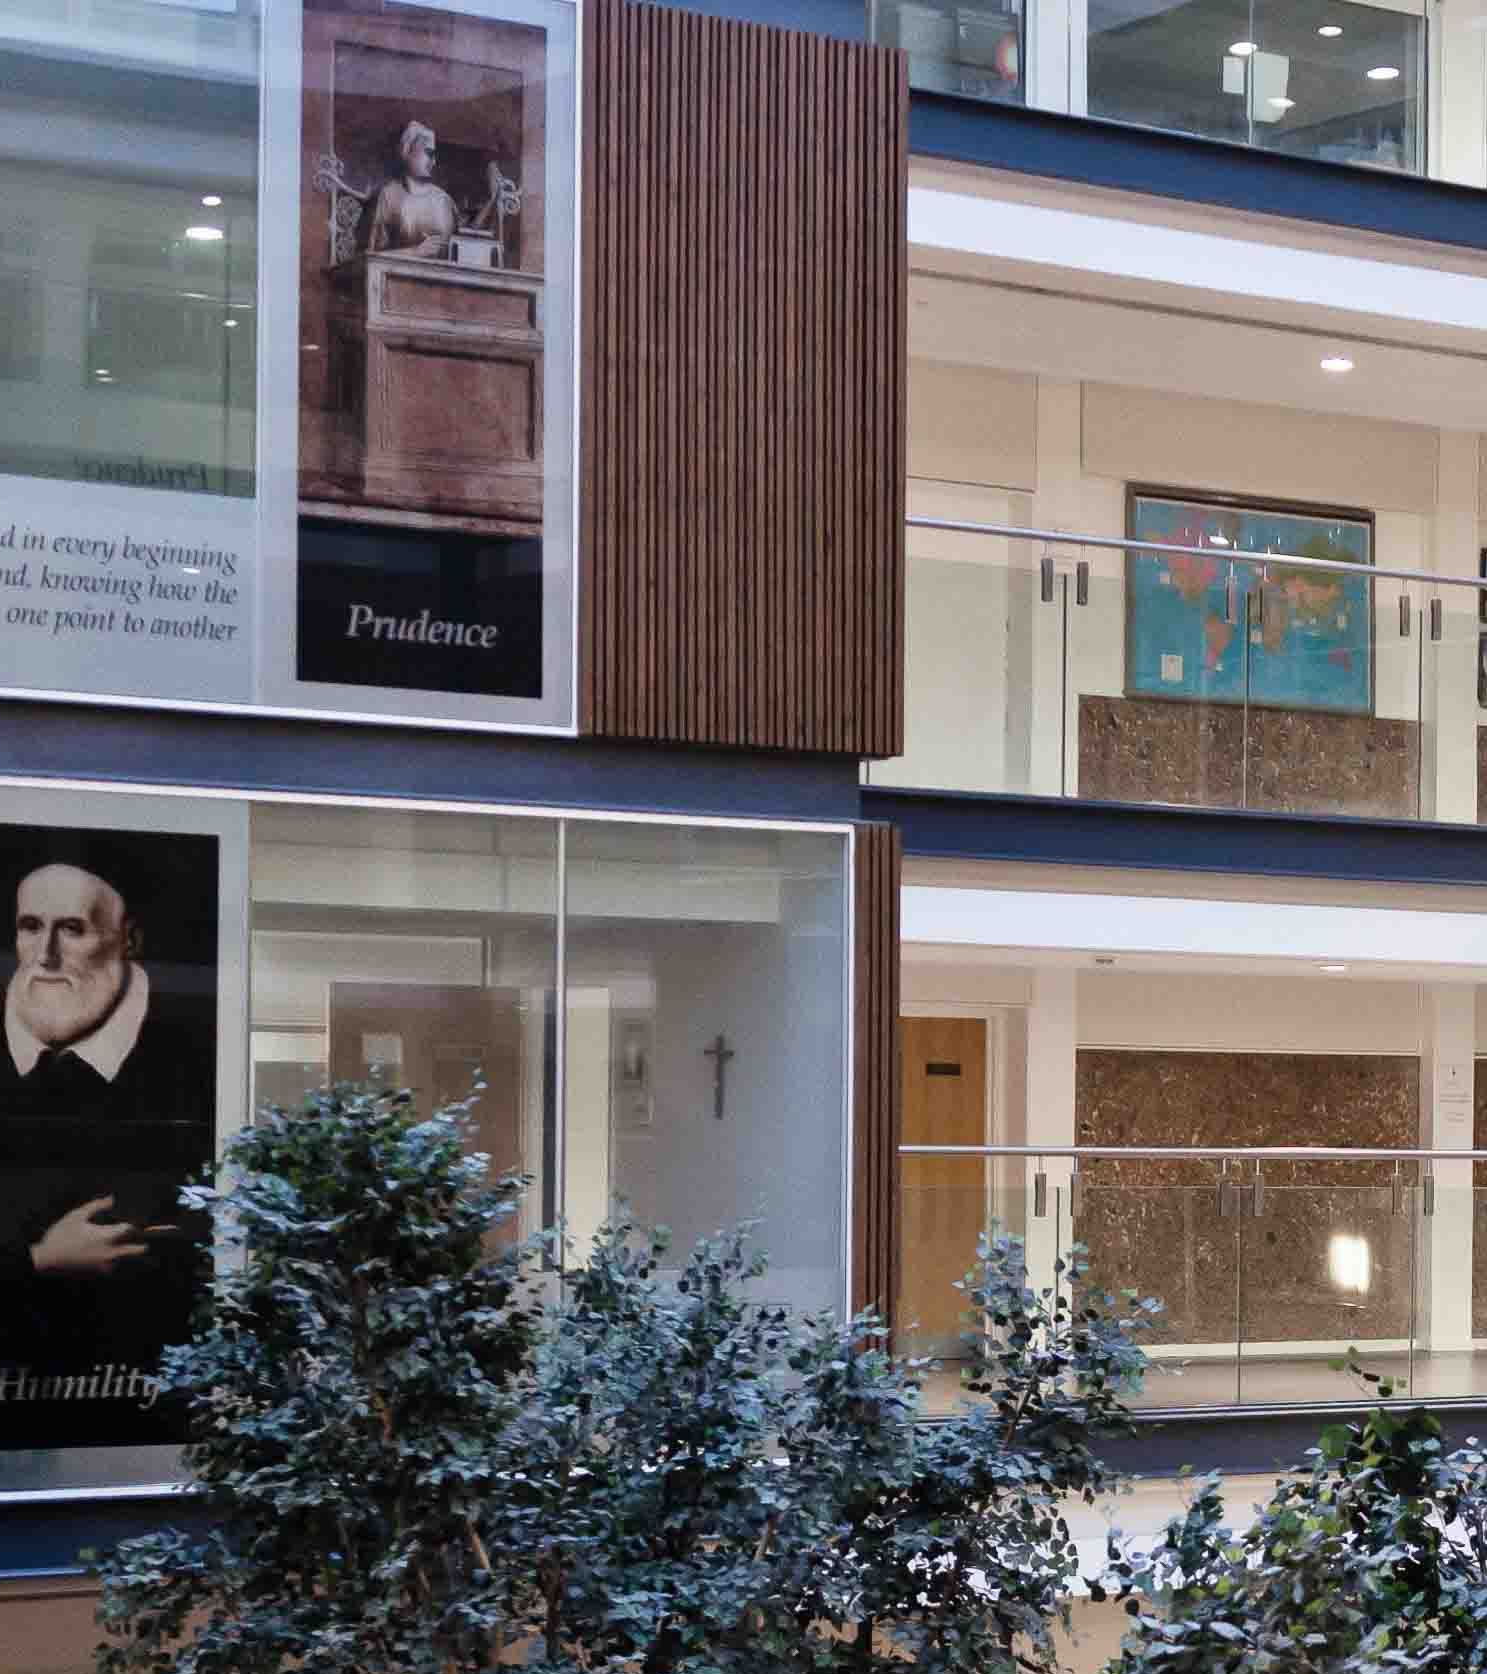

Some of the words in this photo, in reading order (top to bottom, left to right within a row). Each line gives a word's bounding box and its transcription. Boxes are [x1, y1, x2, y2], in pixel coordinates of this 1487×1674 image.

[22, 526, 48, 551] in
[52, 535, 116, 565] every
[122, 534, 239, 576] beginning
[39, 563, 144, 604] knowing
[148, 574, 198, 602] how
[203, 579, 239, 605] the
[6, 605, 48, 626] one
[52, 604, 115, 636] point
[124, 612, 145, 634] to
[150, 615, 239, 642] another
[344, 602, 499, 648] Prudence
